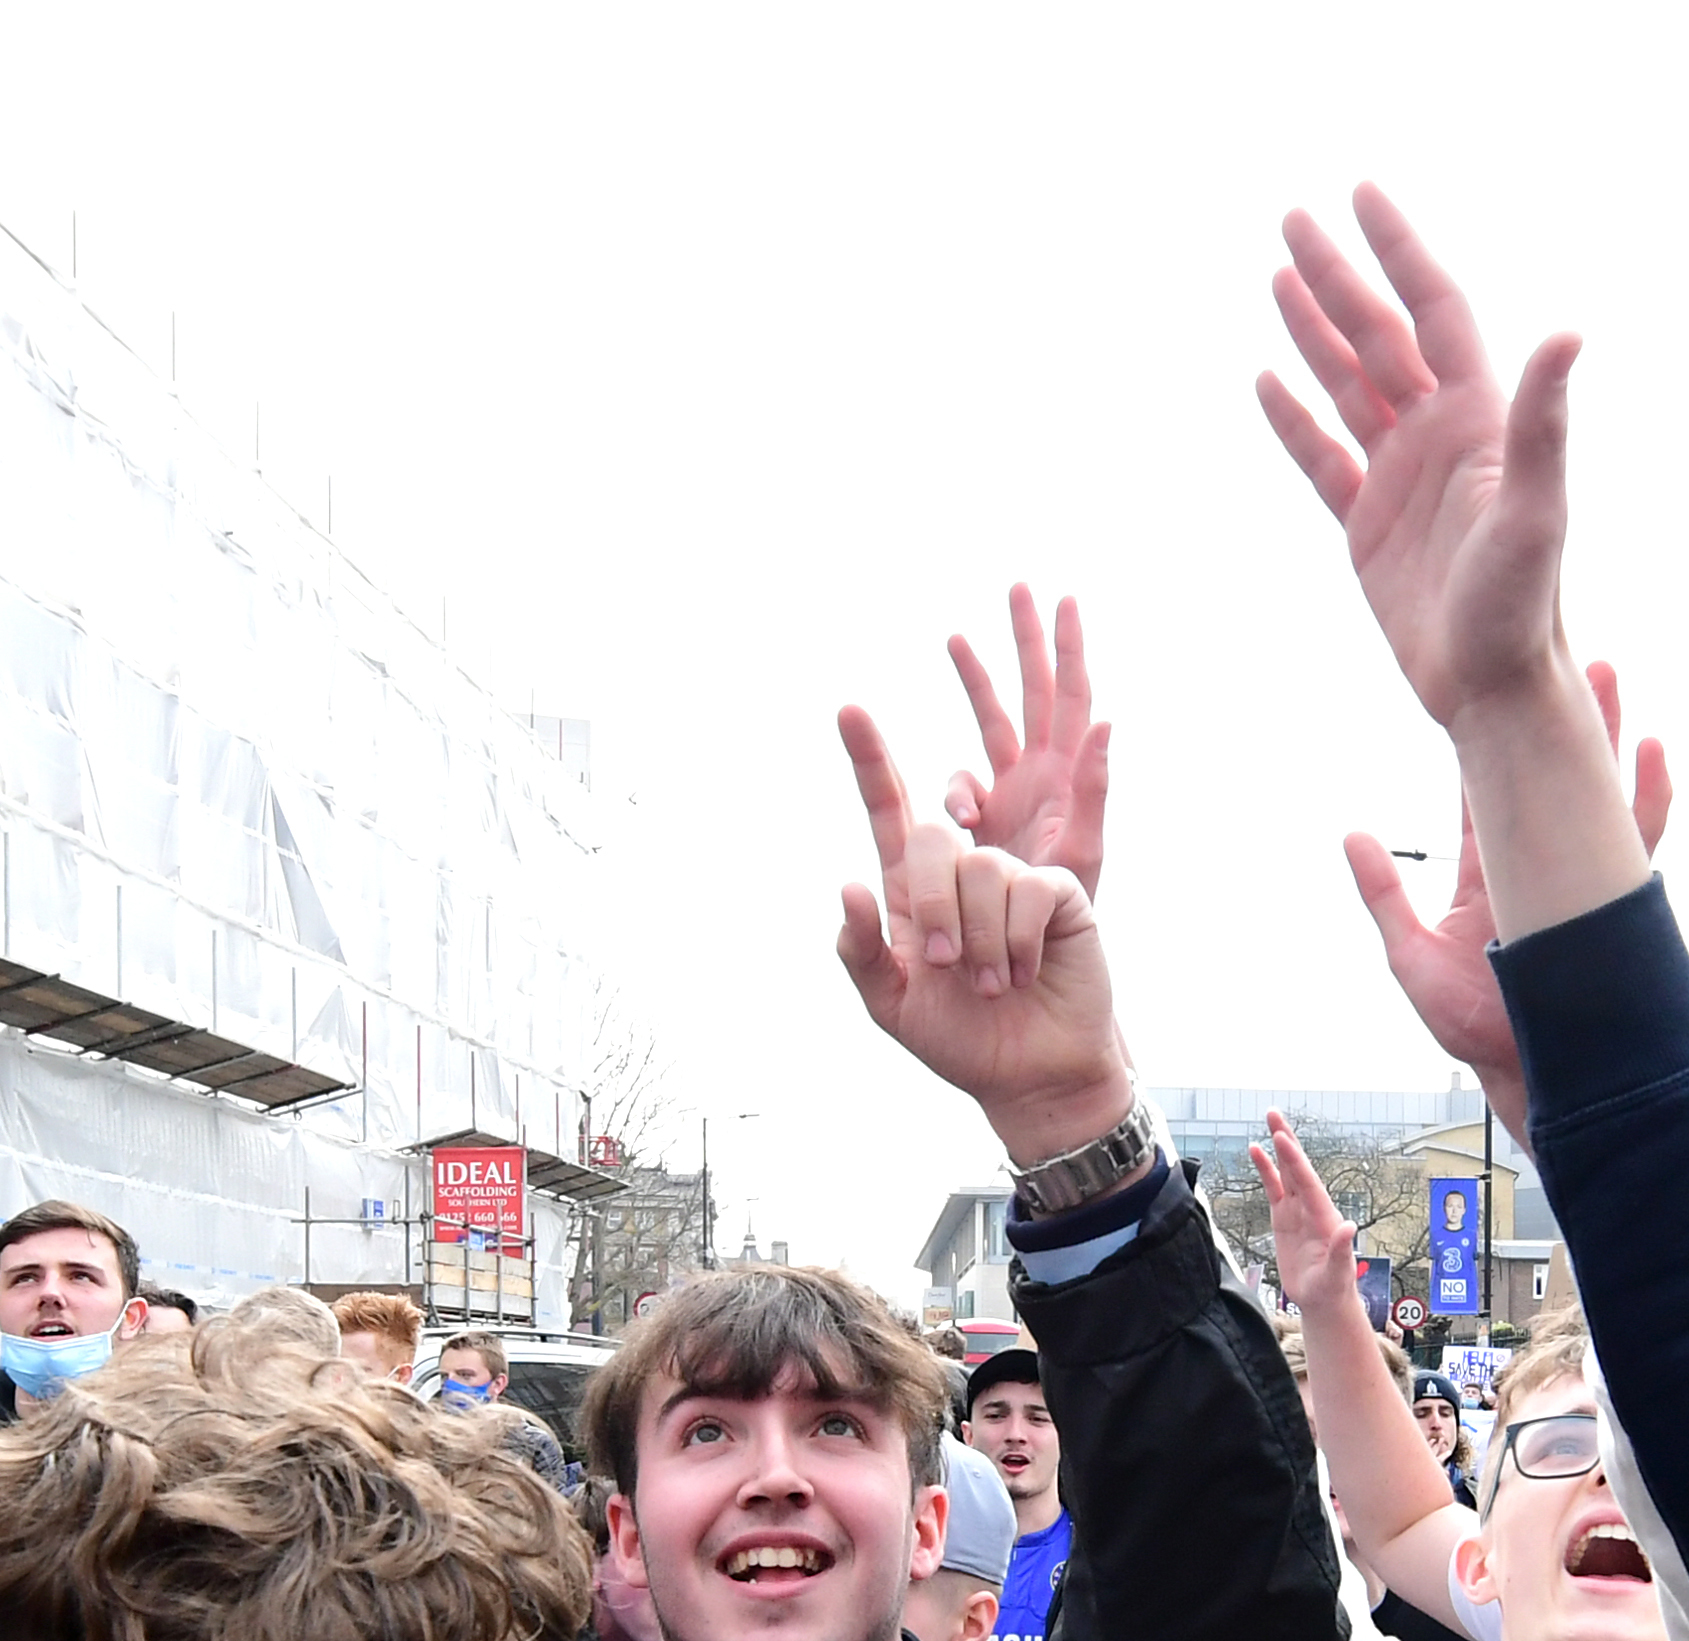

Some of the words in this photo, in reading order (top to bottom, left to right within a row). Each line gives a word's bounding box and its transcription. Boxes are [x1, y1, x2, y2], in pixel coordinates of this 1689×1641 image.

[438, 1161, 517, 1185] IDEAL
[438, 1186, 517, 1197] SCAFFOLDING
[448, 1199, 491, 1207] SOUHERN
[474, 1212, 494, 1223] 660
[498, 1212, 517, 1222] 66
[1442, 1281, 1464, 1293] NO
[1399, 1306, 1421, 1320] 20
